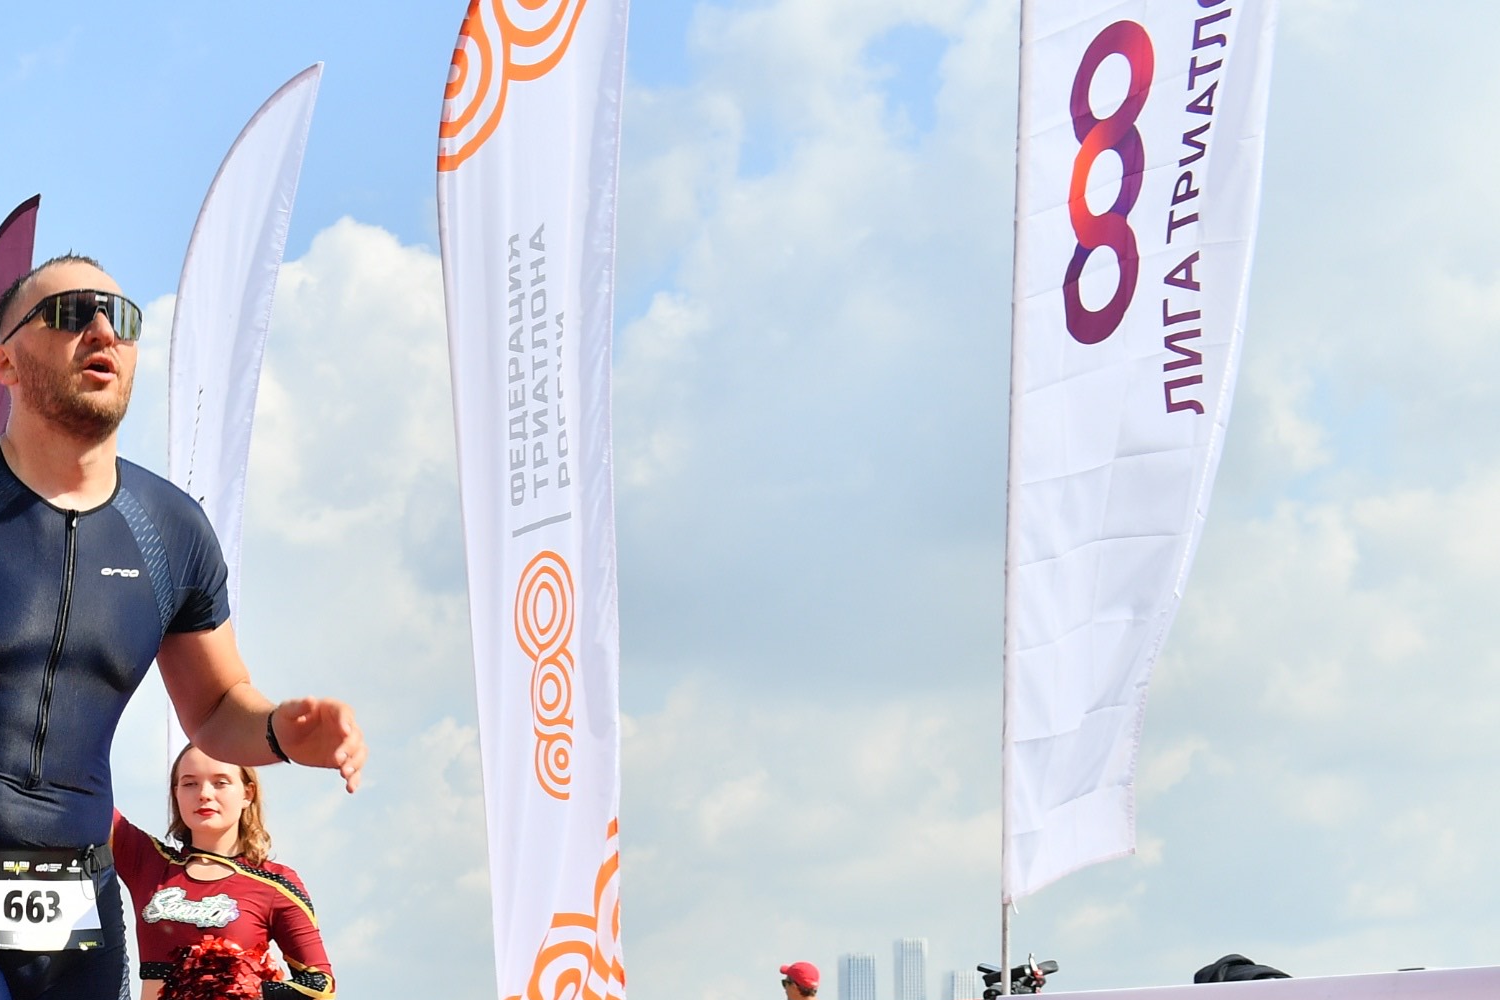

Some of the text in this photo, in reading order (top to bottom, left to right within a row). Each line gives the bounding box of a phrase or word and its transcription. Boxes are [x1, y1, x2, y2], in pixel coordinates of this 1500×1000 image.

[508, 232, 528, 506] ФЕДЕРАЦИЯ
[529, 222, 549, 498] ТРИАТЛОНА
[1163, 250, 1205, 415] ЛИГА
[3, 890, 62, 923] 663
